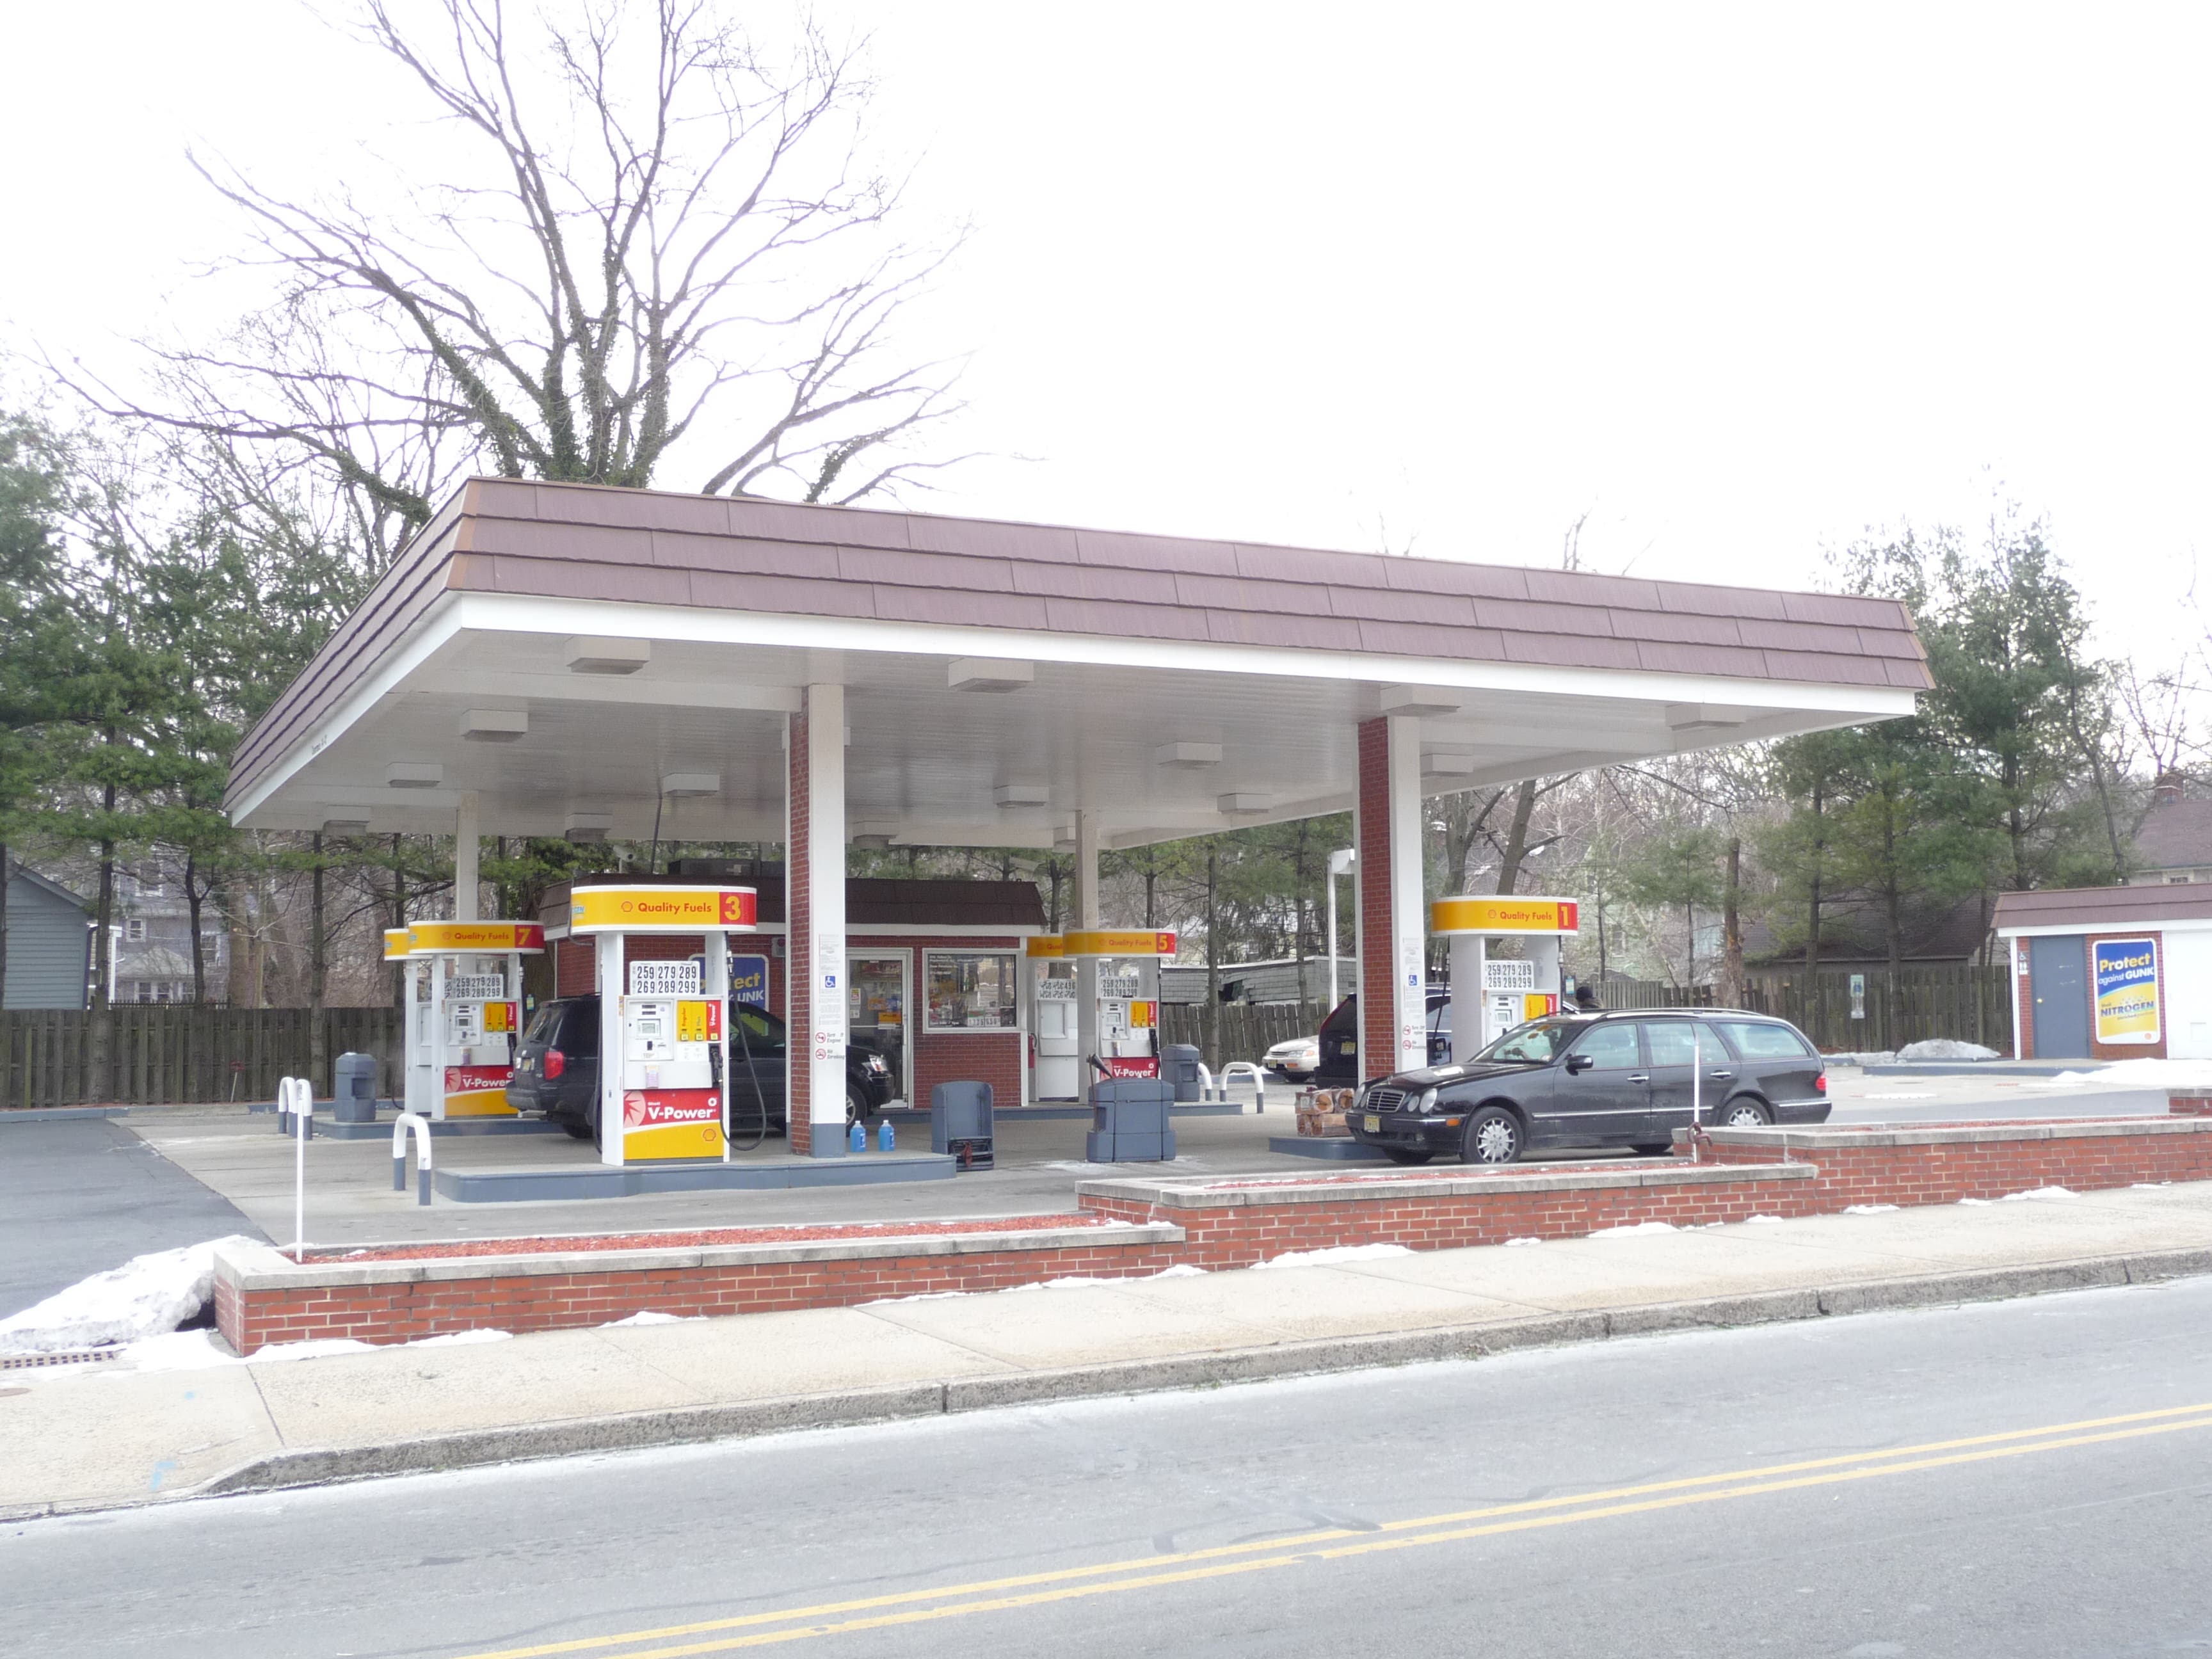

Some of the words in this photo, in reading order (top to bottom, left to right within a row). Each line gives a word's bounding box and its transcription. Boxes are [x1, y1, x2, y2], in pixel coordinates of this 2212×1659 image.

[638, 902, 680, 915] Quality
[684, 903, 712, 912] Fuels
[725, 896, 741, 920] 3
[1500, 911, 1530, 922] Quality
[1532, 911, 1552, 920] Fuels
[1561, 906, 1569, 926] 1
[454, 933, 485, 942] Quality
[518, 929, 531, 945] 7
[1109, 939, 1134, 947] Quality
[1158, 935, 1167, 950] 5
[2099, 953, 2151, 973] Protect
[637, 966, 654, 979] 259
[658, 966, 676, 979] 279
[679, 966, 696, 979] 289
[1488, 965, 1500, 975] 259
[1503, 965, 1516, 975] 279
[1518, 965, 1531, 975] 289
[2098, 973, 2124, 986] against
[2125, 966, 2154, 980] GUNK
[456, 977, 470, 988] 259
[472, 977, 485, 987] 279
[487, 977, 500, 987] 289
[637, 981, 655, 993] 269
[658, 981, 676, 993] 289
[678, 981, 696, 993] 299
[1115, 979, 1126, 988] 279
[1488, 977, 1501, 988] 269
[1503, 977, 1516, 988] 289
[1518, 977, 1531, 988] 299
[456, 988, 470, 998] 269
[472, 988, 485, 998] 289
[487, 988, 500, 997] 299
[2101, 1000, 2154, 1017] NITROGEN
[1114, 1068, 1151, 1077] V-Power
[462, 1078, 512, 1087] V-Power
[648, 1106, 713, 1119] V-Power
